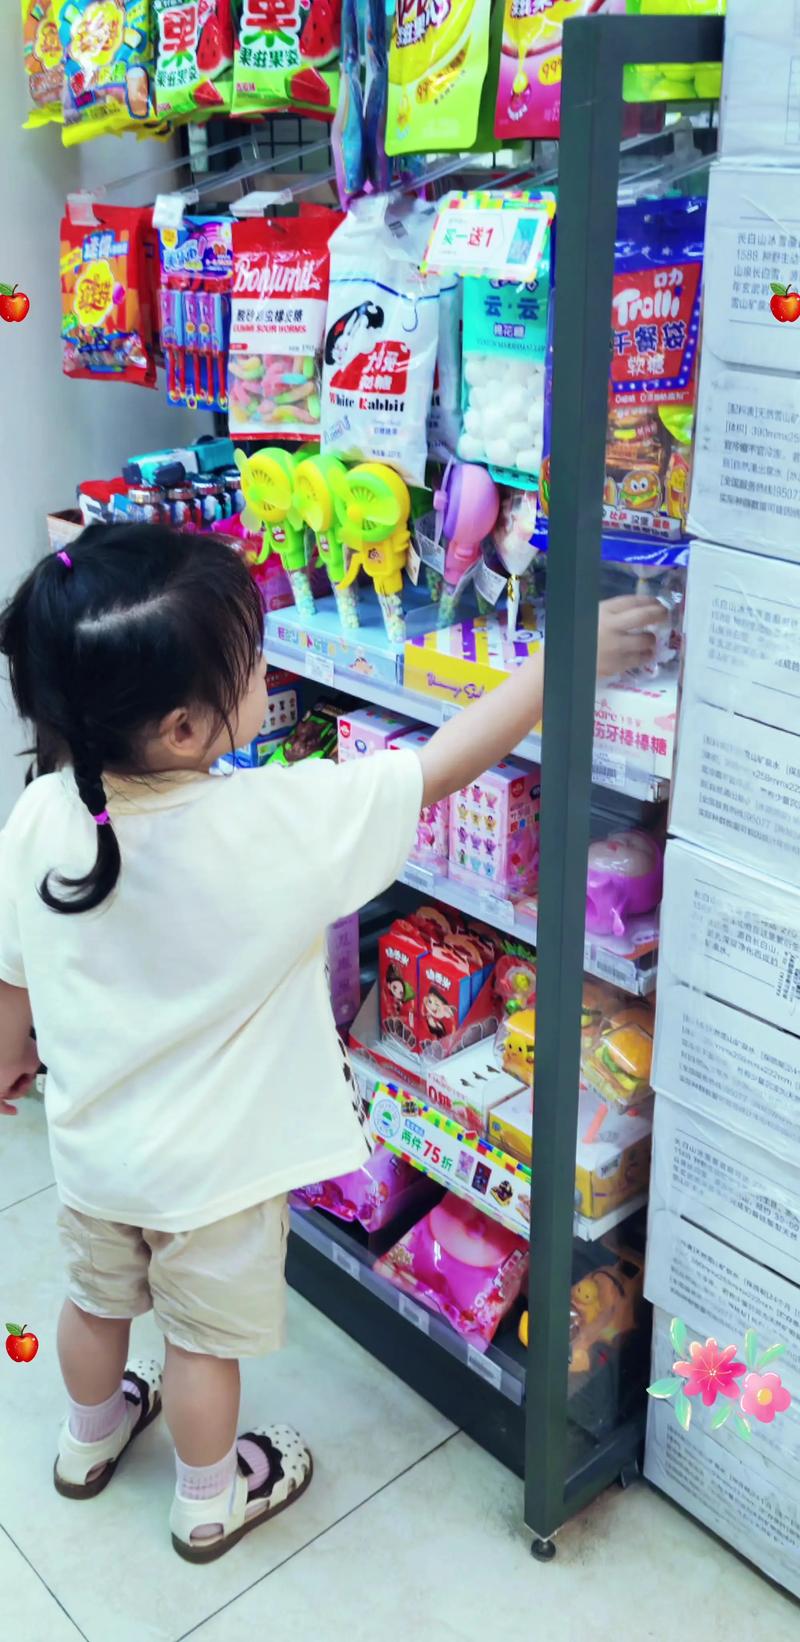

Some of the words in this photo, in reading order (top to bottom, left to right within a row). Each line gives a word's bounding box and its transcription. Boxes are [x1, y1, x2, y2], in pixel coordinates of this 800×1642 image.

[655, 268, 684, 288] 口力
[612, 286, 681, 326] Trolli
[627, 355, 665, 376] 软糖
[329, 391, 354, 408] White
[359, 397, 405, 413] Rabbit
